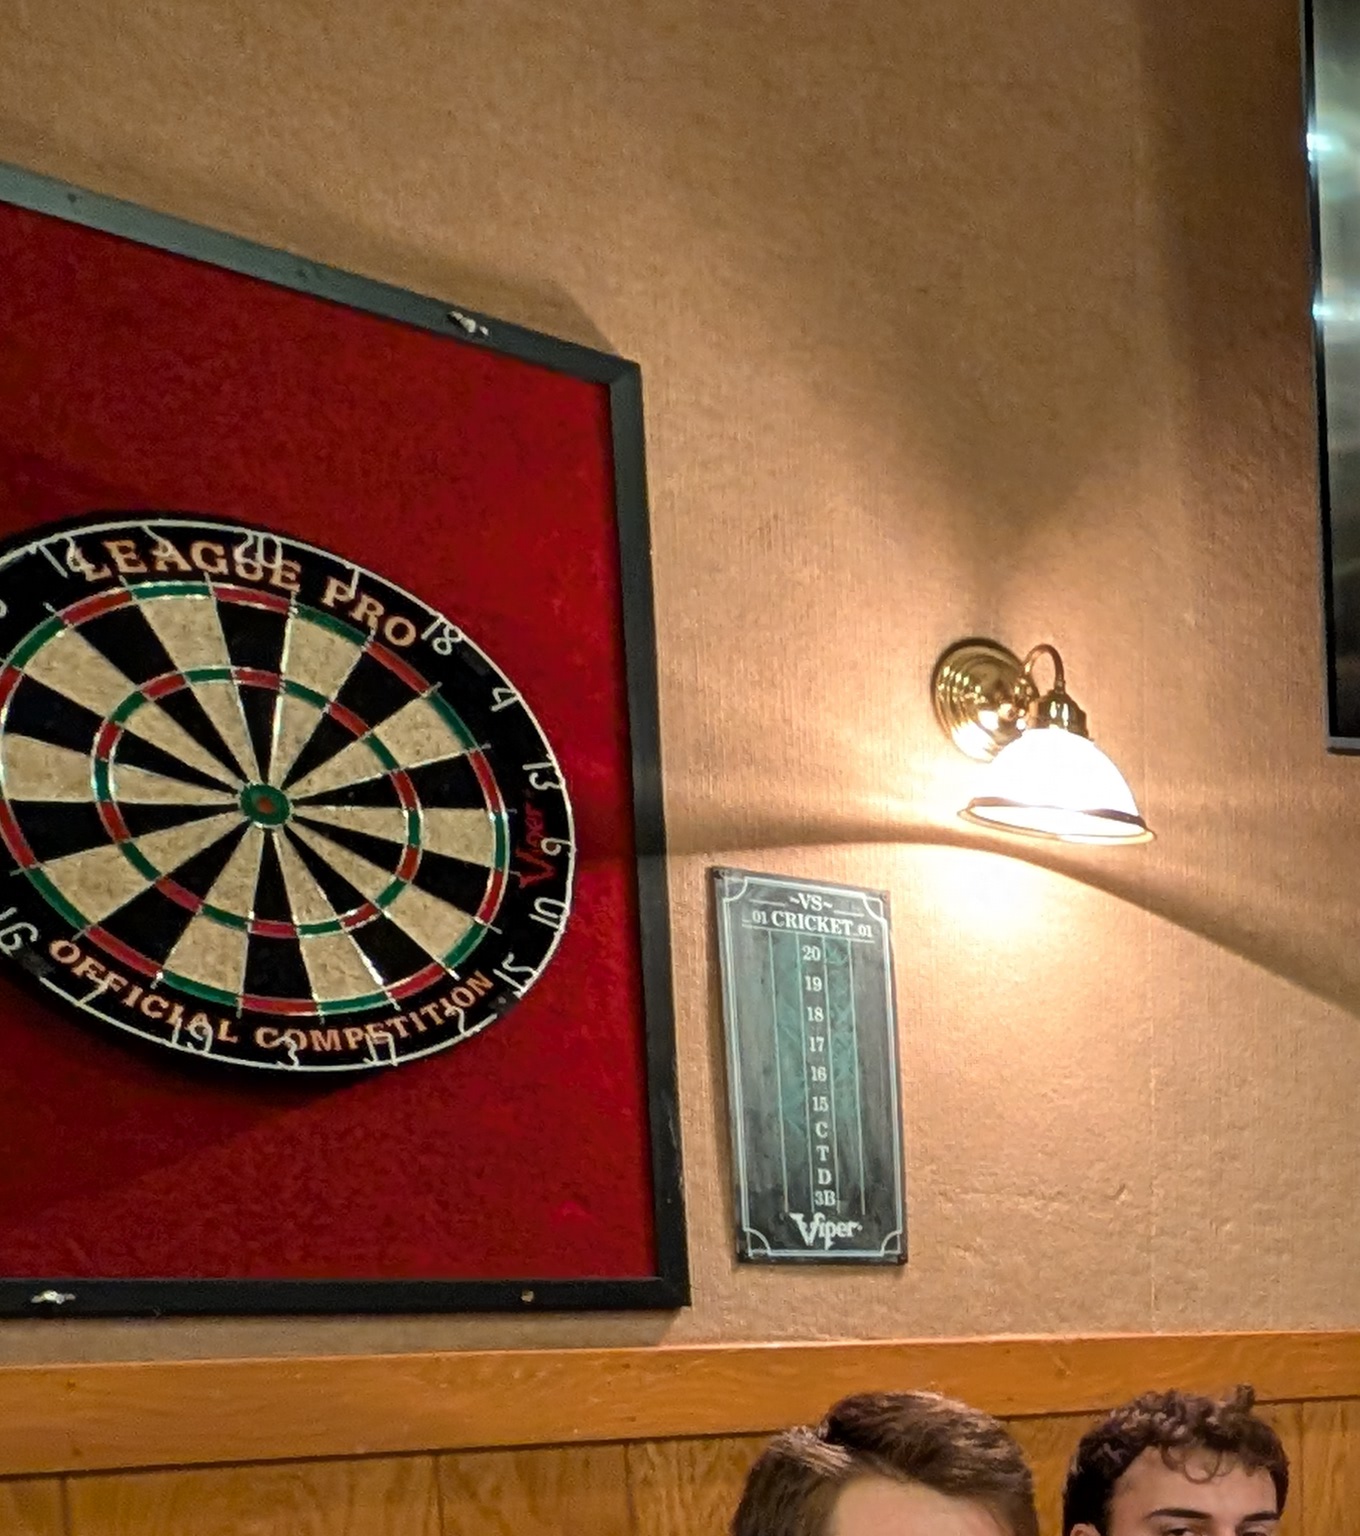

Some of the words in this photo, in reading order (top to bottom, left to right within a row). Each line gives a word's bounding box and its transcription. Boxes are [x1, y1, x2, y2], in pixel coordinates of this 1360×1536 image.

[67, 539, 302, 592] LEAGUE
[321, 575, 417, 648] PRO
[421, 613, 465, 656] 18
[490, 686, 521, 713] 4
[522, 760, 564, 791] 13
[528, 896, 567, 930] 10
[770, 909, 854, 937] CRICKET
[802, 945, 821, 961] 20
[805, 975, 823, 992] 19
[49, 938, 239, 1044] OFFICIAL
[254, 969, 495, 1053] COMPETITION
[807, 1006, 825, 1022] 18
[809, 1036, 826, 1053] 17
[811, 1065, 828, 1082] 16
[812, 1095, 830, 1113] 15
[815, 1120, 829, 1139] C
[816, 1144, 831, 1162] T
[817, 1167, 833, 1186] D
[788, 1211, 864, 1251] Viper
